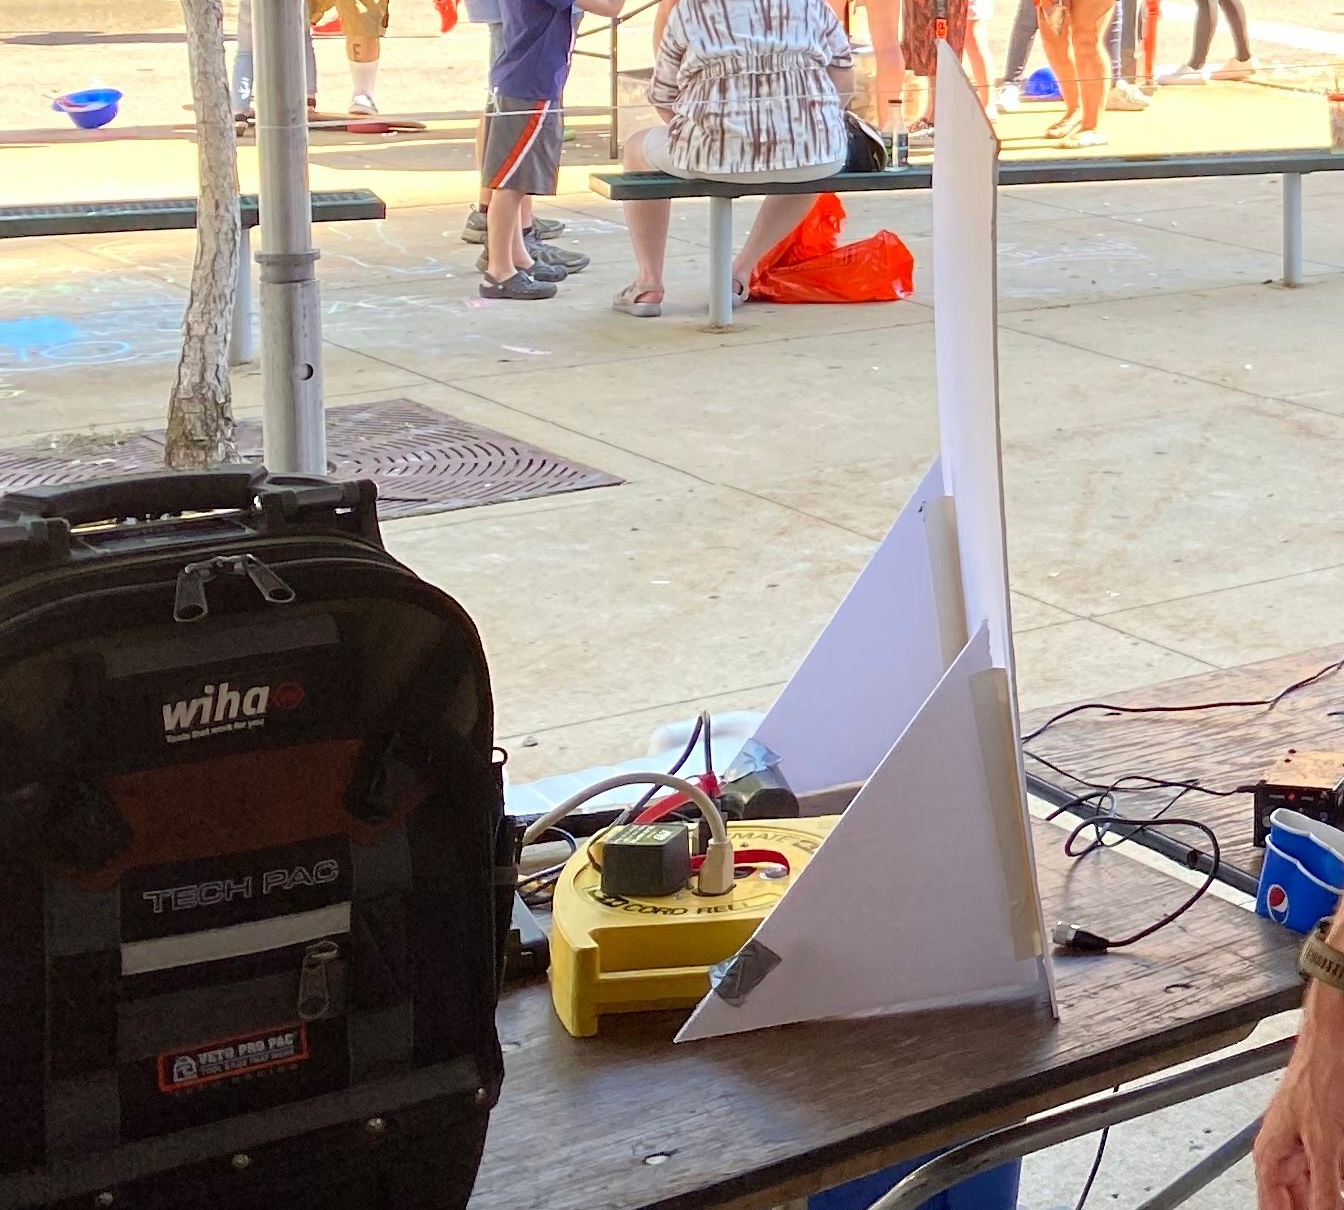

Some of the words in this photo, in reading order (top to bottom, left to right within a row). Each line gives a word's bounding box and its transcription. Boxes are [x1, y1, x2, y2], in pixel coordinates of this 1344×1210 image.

[162, 682, 270, 731] wiha
[143, 876, 253, 914] TECH
[262, 858, 341, 895] PAC
[622, 902, 688, 916] CORD
